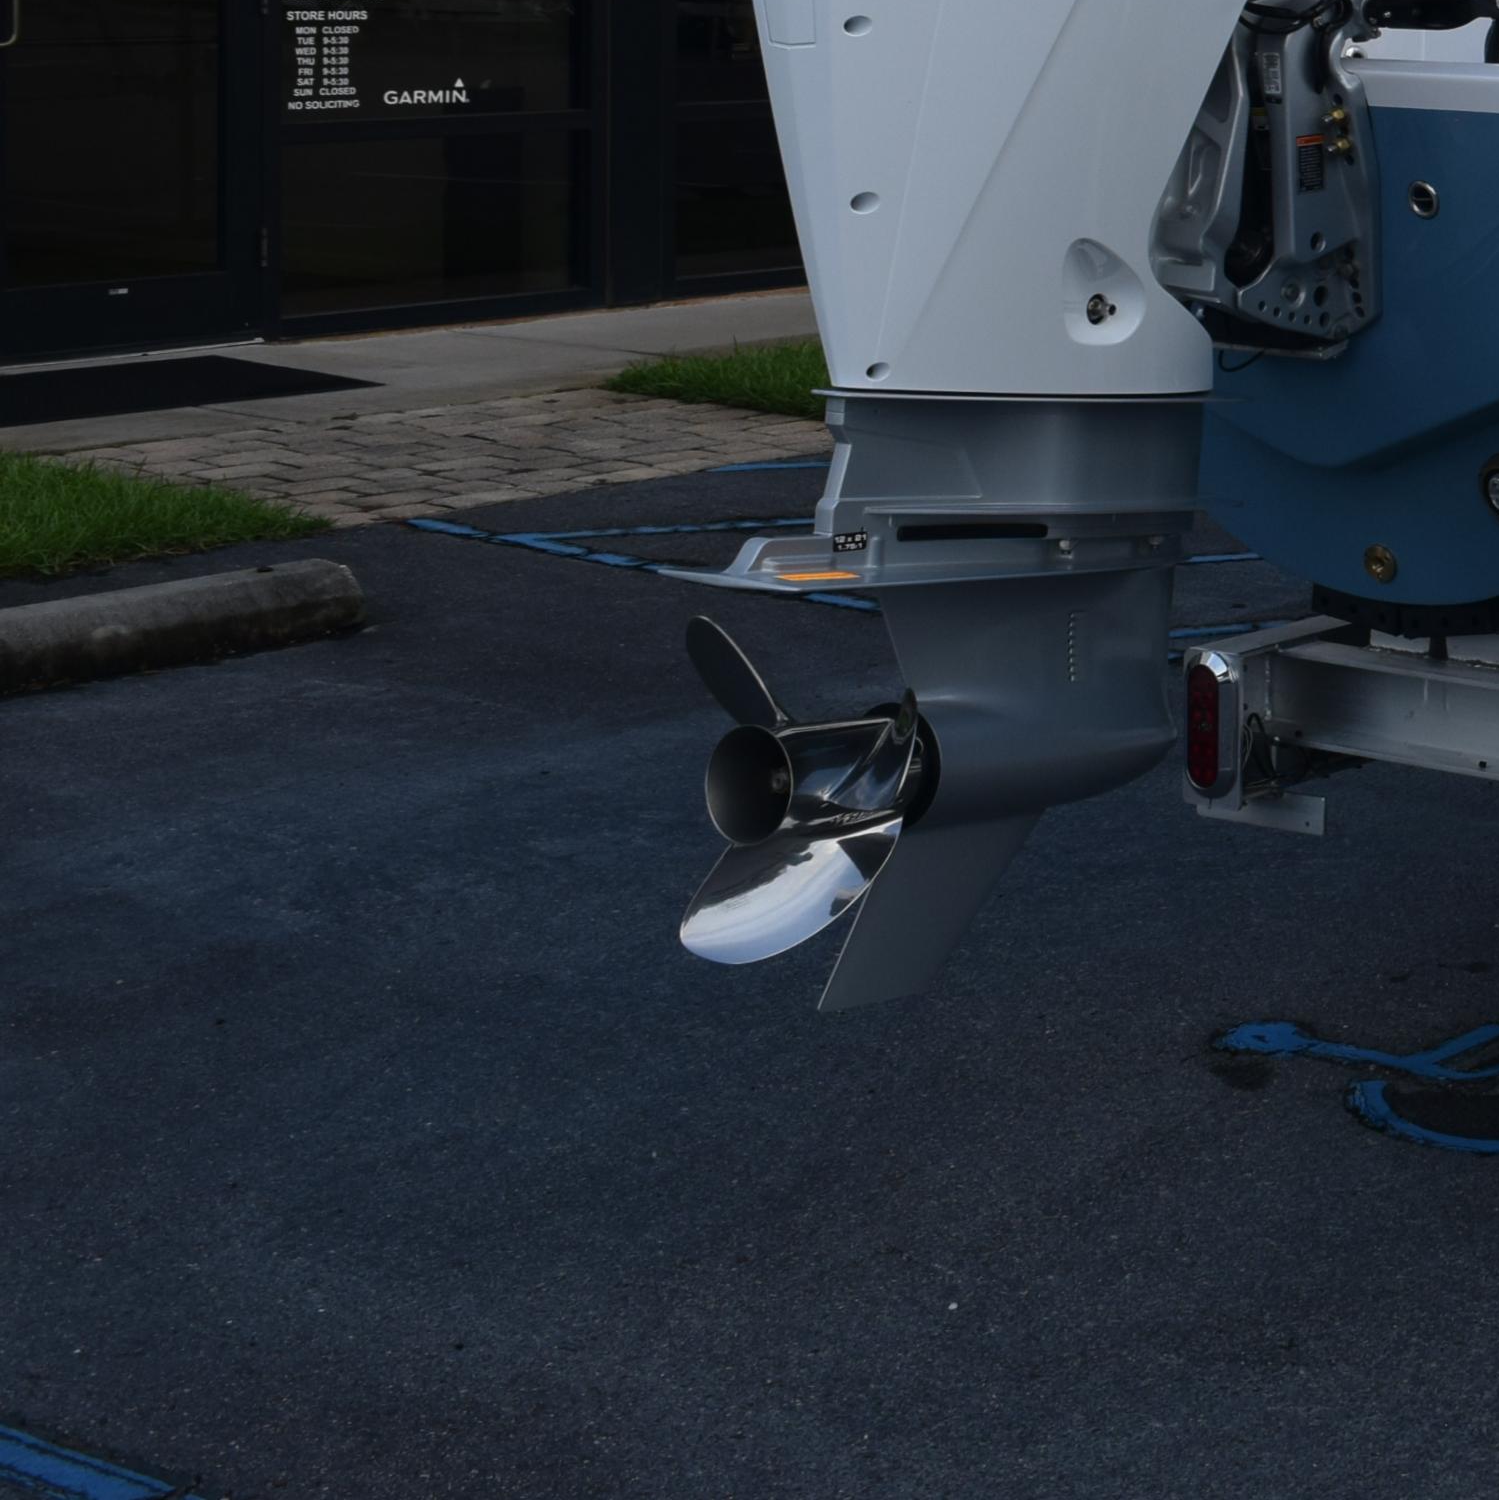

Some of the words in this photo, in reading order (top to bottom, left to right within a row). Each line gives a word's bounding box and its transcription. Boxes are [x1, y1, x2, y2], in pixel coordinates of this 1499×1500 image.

[286, 10, 326, 21] STORE
[328, 10, 368, 20] HOURS
[295, 26, 317, 34] MON
[322, 25, 359, 34] CLOSED
[297, 37, 315, 45] TUE
[295, 47, 317, 55] WED
[296, 57, 316, 65] THU
[298, 67, 314, 76] FRI
[296, 78, 315, 86] SAT
[293, 88, 313, 96] SUN
[319, 87, 357, 96] CLOSED
[383, 89, 468, 105] GARMIN
[287, 101, 303, 110] NO
[305, 99, 360, 110] SOLICITING
